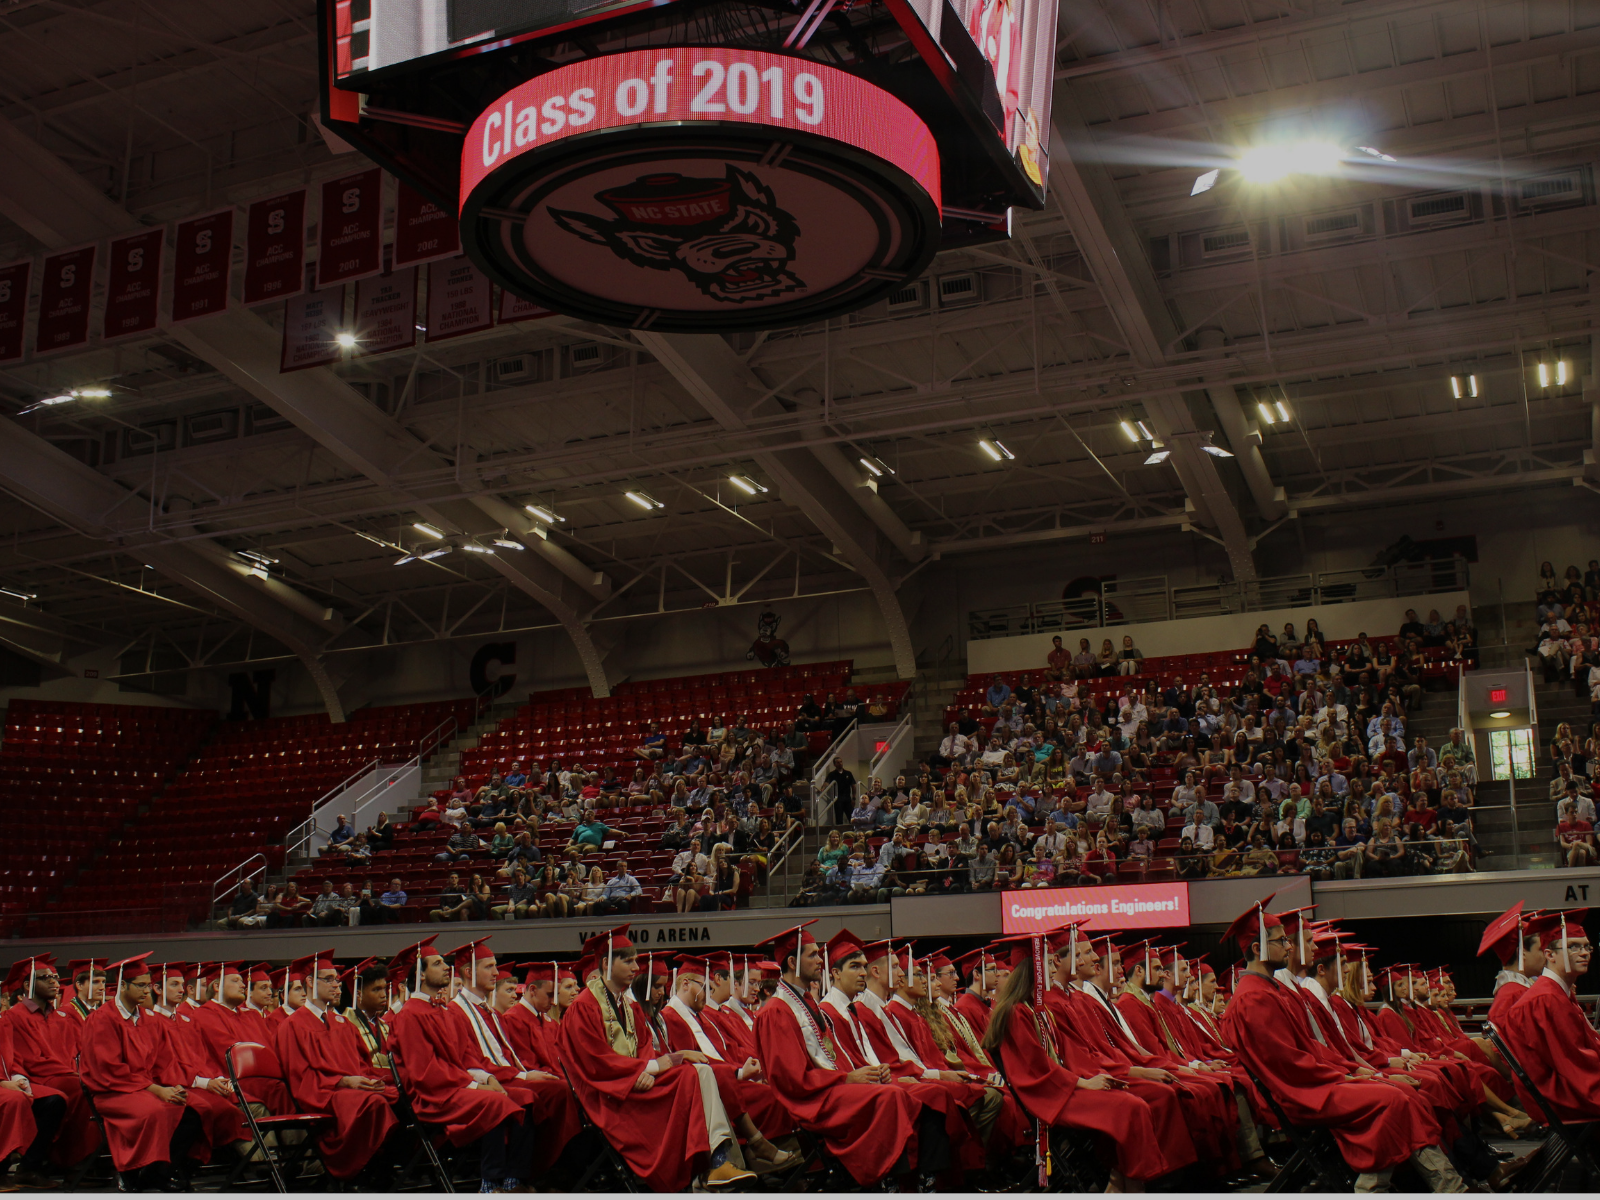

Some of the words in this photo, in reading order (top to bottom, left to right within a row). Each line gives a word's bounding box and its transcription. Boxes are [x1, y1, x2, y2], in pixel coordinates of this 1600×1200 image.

[482, 87, 597, 167] Class
[615, 59, 674, 117] of
[690, 60, 825, 126] 2019
[630, 206, 663, 219] NC
[664, 199, 724, 218] STATE
[342, 222, 359, 236] ACC
[330, 230, 371, 247] CHAMPIONS
[417, 238, 439, 253] 2002
[266, 244, 284, 256] ACC
[256, 250, 294, 268] CHAMPIONS
[339, 258, 360, 273] 2001
[194, 263, 211, 275] ACC
[449, 266, 471, 277] SCOTT
[183, 270, 220, 287] CHAMPIONS
[447, 274, 474, 286] TURNER
[126, 281, 142, 293] ACC
[263, 280, 282, 293] 1996
[446, 289, 459, 299] 150
[460, 286, 474, 296] LBS
[58, 297, 74, 309] ACC
[115, 288, 151, 303] CHAMPIONS
[371, 292, 401, 305] THACKER
[48, 304, 82, 319] CHAMPIONS
[191, 298, 209, 311] 1991
[305, 300, 324, 310] MATT
[361, 301, 410, 318] HEAVYWEIGHT
[450, 300, 467, 311] 1988
[441, 307, 478, 321] NATIONAL
[122, 316, 140, 328] 1990
[439, 314, 480, 331] CHAMPION
[367, 324, 402, 339] NATIONAL
[365, 332, 404, 349] CHAMPION
[1091, 535, 1104, 544] 211
[469, 640, 518, 699] C
[226, 668, 277, 722] N
[1491, 690, 1506, 701] EXIT
[1011, 901, 1109, 920] Congratulations
[1111, 896, 1179, 915] Engineers!
[656, 927, 711, 943] ARENA
[1033, 937, 1041, 961] REMOVE
[1035, 961, 1043, 984] BEFORE
